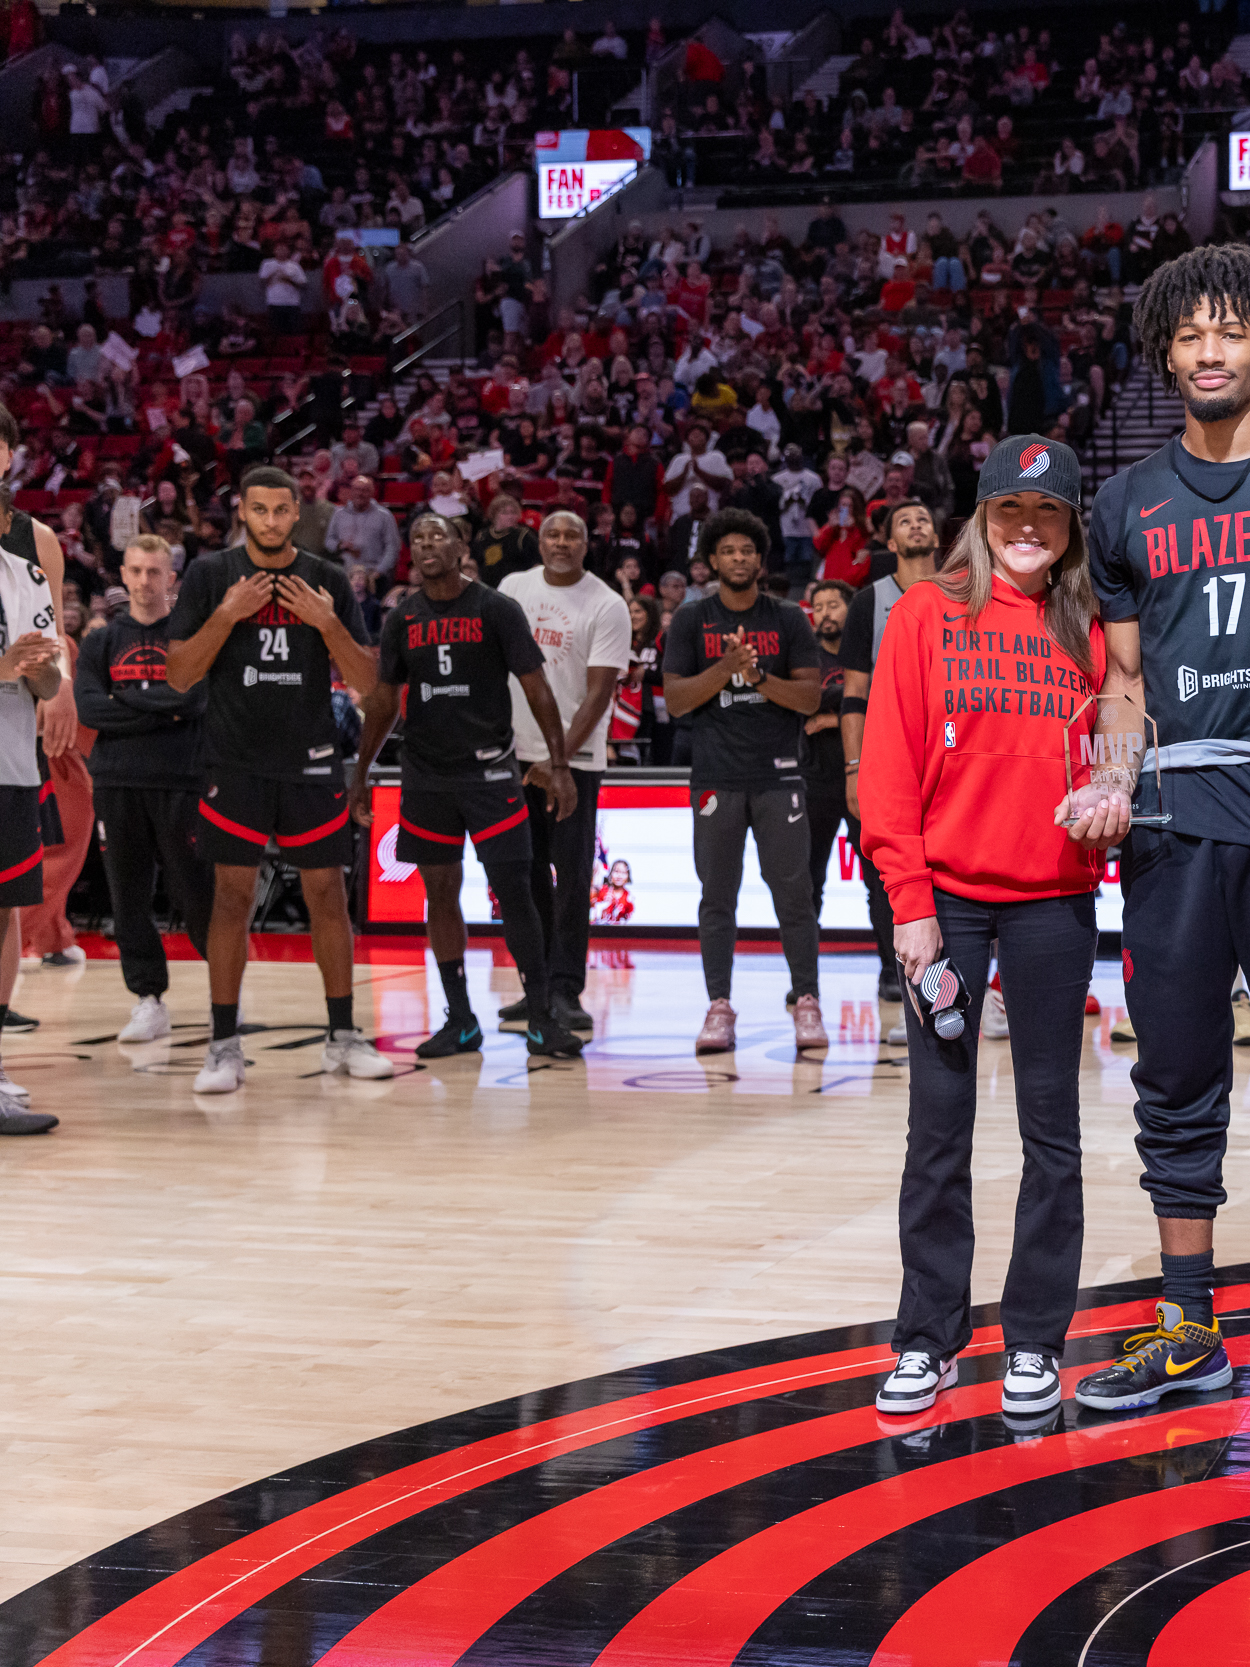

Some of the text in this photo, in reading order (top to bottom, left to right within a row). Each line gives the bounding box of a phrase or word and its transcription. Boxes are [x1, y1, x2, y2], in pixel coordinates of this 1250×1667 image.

[547, 168, 584, 191] FAN
[548, 194, 584, 209] FEST
[1202, 573, 1246, 636] 17
[258, 627, 290, 661] 24
[408, 616, 483, 650] BLAZERS
[942, 628, 1051, 658] PORTLAND
[437, 644, 452, 675] 5
[258, 672, 303, 682] BRIGHTSIDE
[942, 658, 1094, 703] TRAIL BLAZERS
[944, 687, 1078, 722] BASKETBALL
[1079, 732, 1143, 766] MVP
